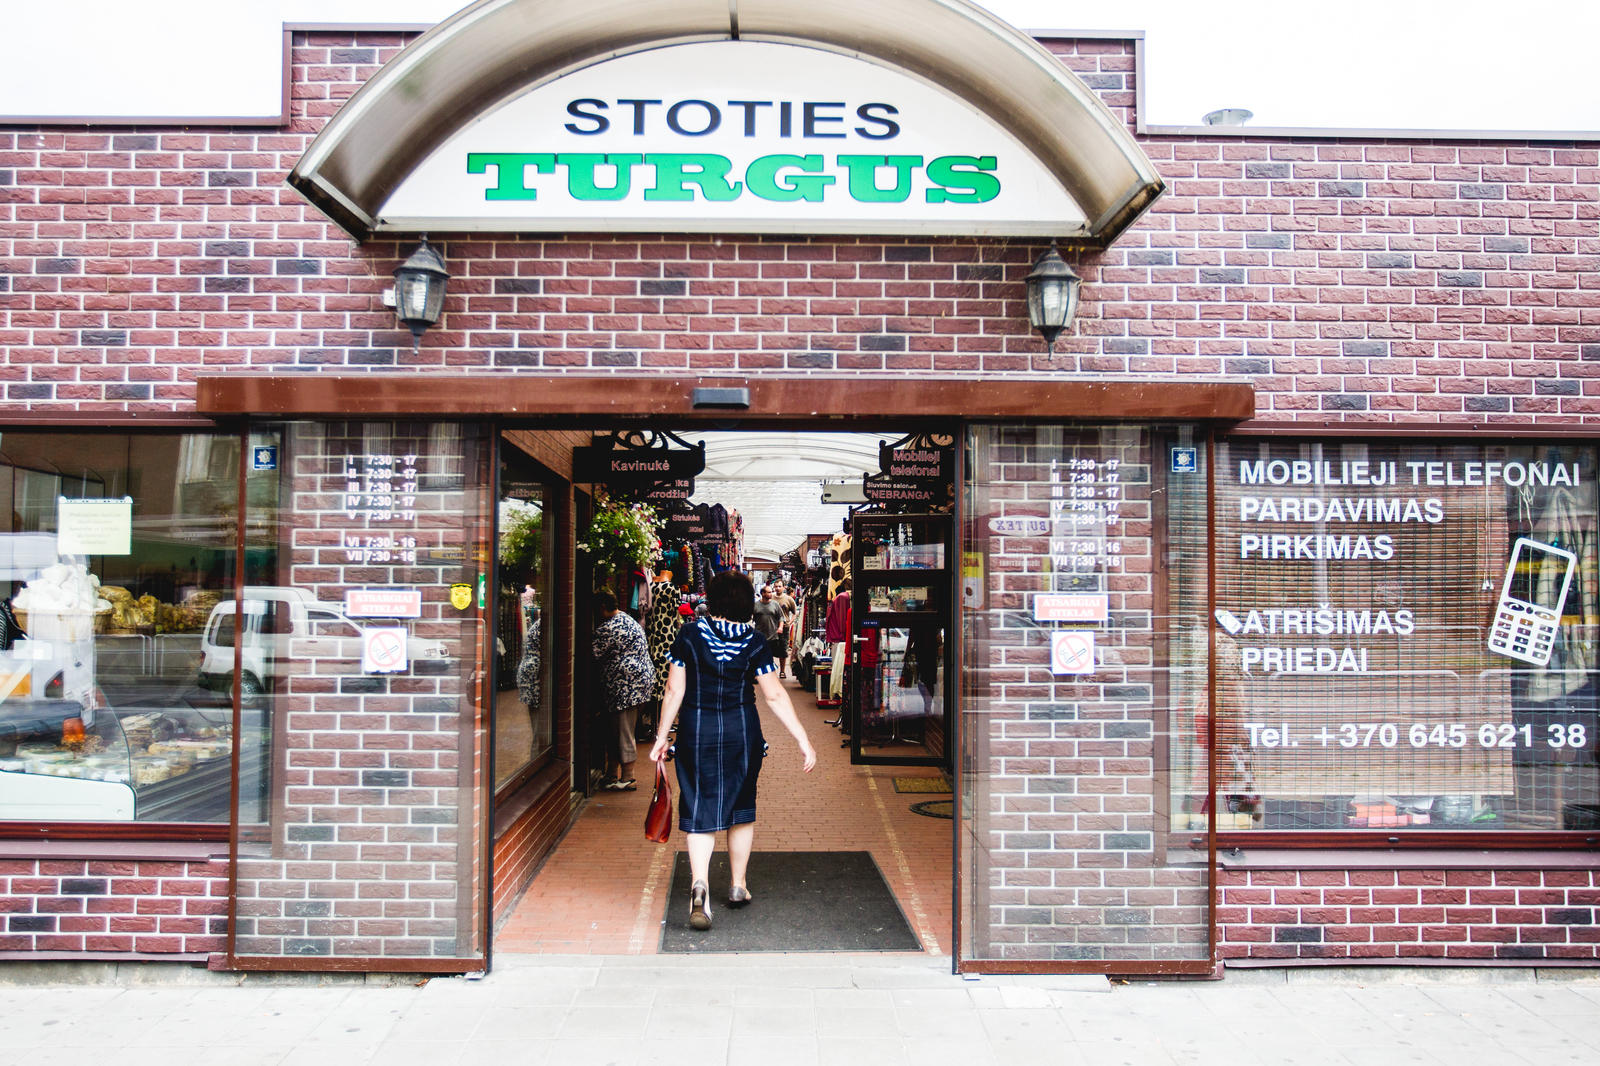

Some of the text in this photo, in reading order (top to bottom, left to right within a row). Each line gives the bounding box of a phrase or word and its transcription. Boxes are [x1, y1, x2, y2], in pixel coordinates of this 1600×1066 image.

[564, 98, 901, 140] STOTIES
[467, 152, 1001, 203] TURGUS
[367, 455, 392, 465] 7:30
[404, 455, 417, 465] 17
[893, 449, 940, 464] Mobilieji
[611, 460, 670, 471] Kavinukė
[890, 464, 940, 476] telefonai
[1070, 459, 1095, 470] 7:30
[1106, 459, 1119, 470] 17
[349, 468, 357, 479] II
[366, 468, 392, 479] 7:30
[403, 468, 417, 479] 17
[1052, 473, 1060, 484] II
[1069, 473, 1095, 484] 7:30
[1106, 473, 1119, 484] 17
[1240, 460, 1580, 487] MOBILIEJI TELEFONAI
[348, 482, 360, 493] III
[366, 482, 391, 493] 7:30
[402, 482, 416, 493] 17
[1052, 487, 1063, 498] III
[1070, 487, 1095, 498] 7:30
[1106, 487, 1119, 498] 17
[348, 496, 360, 507] IV
[366, 496, 392, 507] 7:30
[402, 496, 416, 507] 17
[1052, 500, 1064, 511] IV
[1070, 500, 1095, 511] 7:30
[1106, 500, 1119, 511] 17
[348, 509, 357, 520] V
[366, 509, 391, 520] 7:30
[402, 509, 416, 520] 17
[1240, 497, 1444, 523] PARDAVIMAS
[1052, 514, 1061, 525] V
[1070, 514, 1095, 525] 7:30
[1106, 514, 1119, 525] 17
[346, 537, 360, 548] VI
[365, 537, 391, 548] 7:30
[401, 537, 416, 548] 16
[1052, 542, 1065, 553] VI
[1070, 542, 1095, 553] 7:30
[1106, 542, 1120, 553] 16
[1240, 535, 1394, 560] PIRKIMAS
[346, 550, 363, 561] VII
[365, 550, 391, 561] 7:30
[400, 550, 416, 561] 16
[1053, 556, 1067, 567] VII
[1070, 556, 1095, 567] 7:30
[1106, 556, 1120, 567] 16
[1242, 602, 1415, 635] ATRIŠIMAS
[1242, 647, 1367, 672] PRIEDAI
[1244, 722, 1587, 748] Tel. +370 645 621 38
